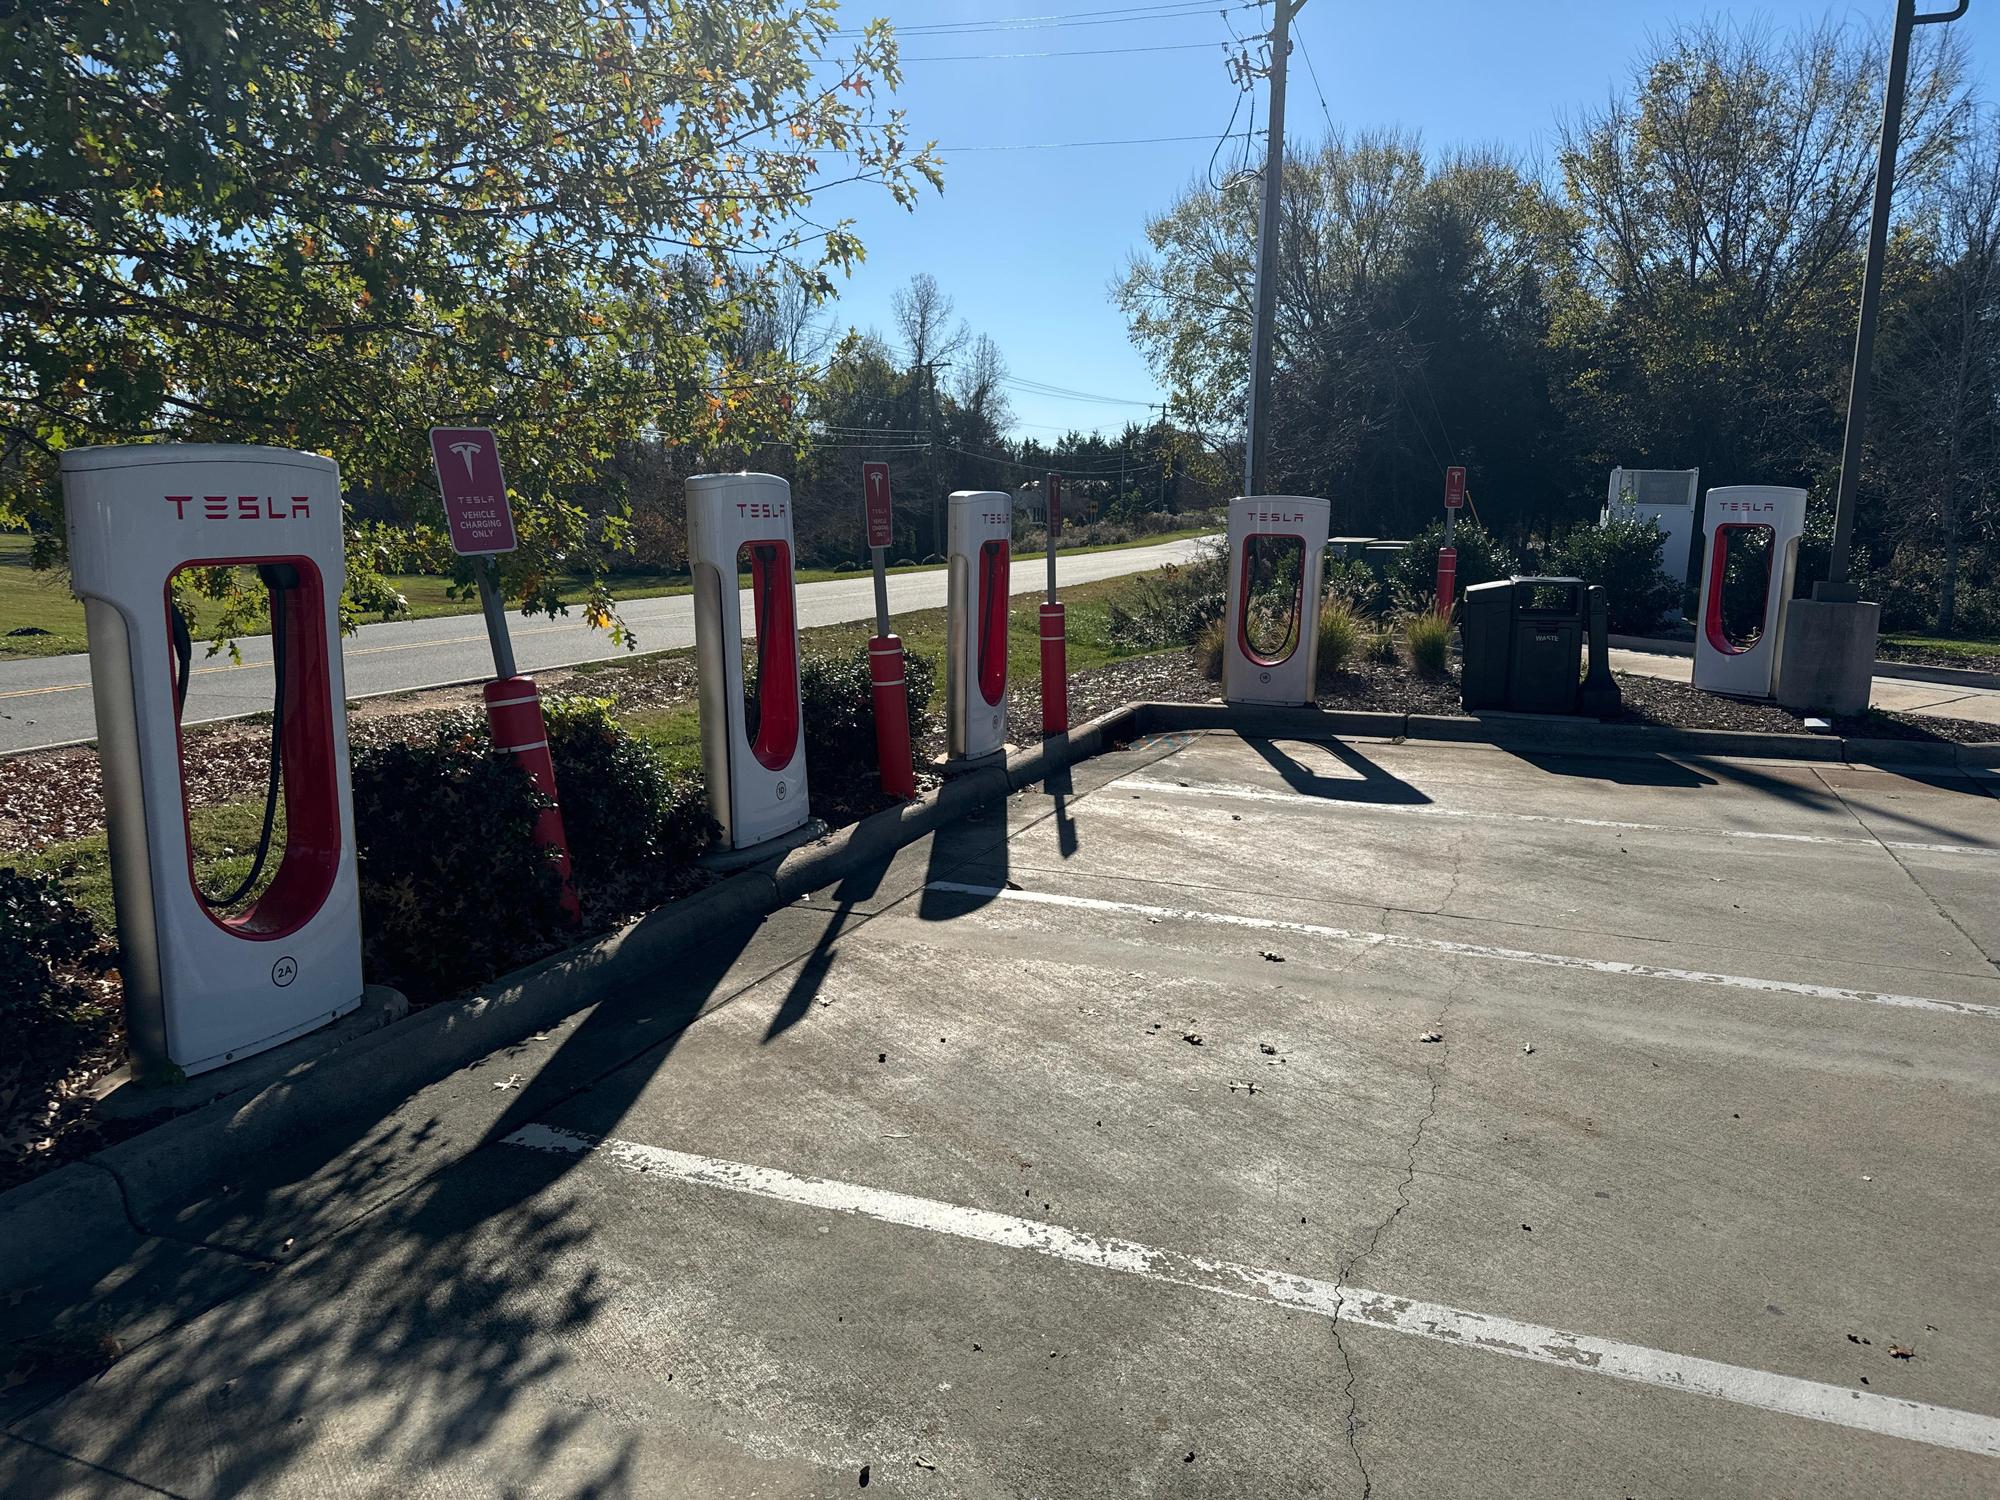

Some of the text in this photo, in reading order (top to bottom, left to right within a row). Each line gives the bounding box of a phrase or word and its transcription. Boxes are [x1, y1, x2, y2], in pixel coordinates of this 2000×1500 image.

[457, 495, 495, 505] TESLA
[164, 496, 310, 520] TESLA
[736, 503, 786, 518] TESLA
[1719, 502, 1774, 512] TESLA
[462, 510, 496, 519] VEHICLE
[1247, 512, 1304, 522] TESLA
[460, 519, 502, 530] CHARGING
[472, 530, 494, 539] ONLY
[277, 965, 293, 978] 2A
